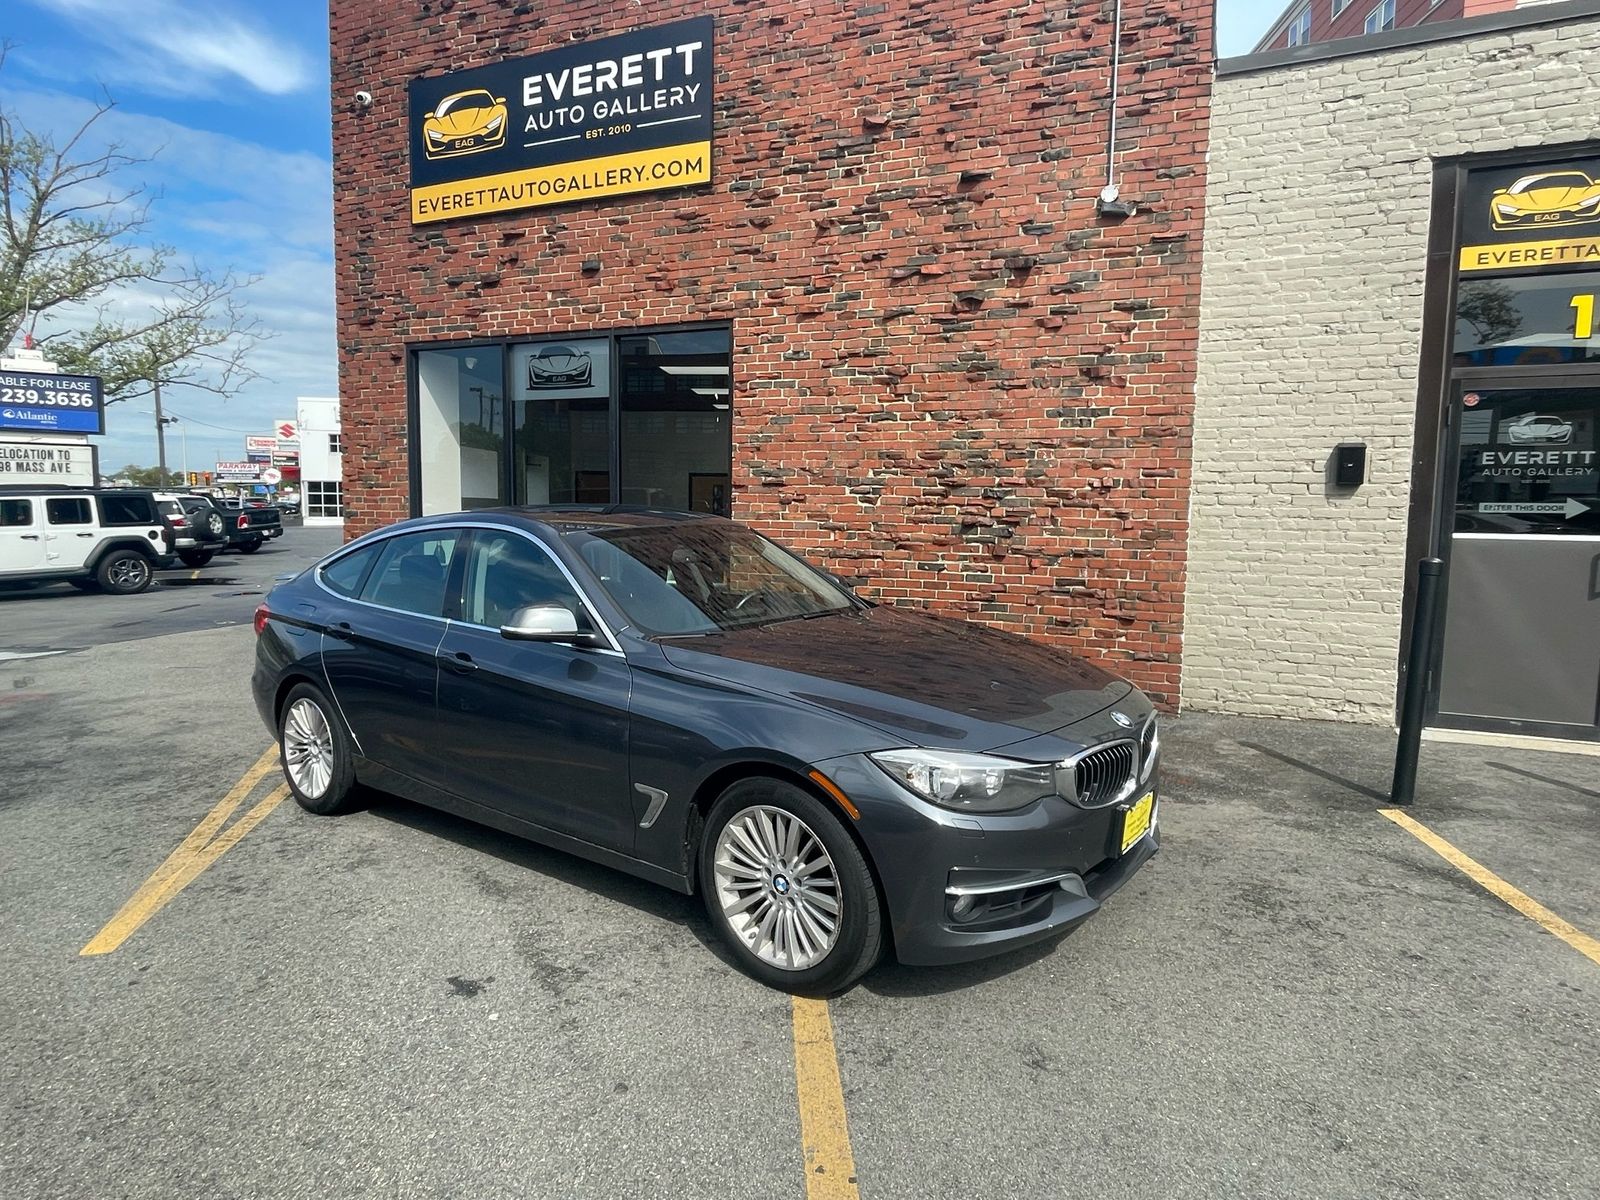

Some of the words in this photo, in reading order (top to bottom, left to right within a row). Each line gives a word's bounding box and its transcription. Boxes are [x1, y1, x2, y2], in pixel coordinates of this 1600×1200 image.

[522, 41, 703, 107] EVERETT
[524, 104, 585, 133] AUTO
[593, 83, 701, 119] GALLERY
[585, 128, 606, 139] EST.
[608, 124, 632, 136] 2010
[454, 138, 475, 149] EAG
[418, 156, 703, 215] EVERETTAUTOGALLERY.COM
[1534, 213, 1560, 222] EAG
[1569, 293, 1596, 339] 1
[30, 379, 53, 388] FOR
[57, 380, 91, 391] LEASE
[16, 410, 57, 421] Atlantic
[59, 450, 71, 460] TO
[1482, 451, 1596, 465] EVERETT
[16, 462, 45, 473] MASS
[51, 462, 71, 473] AVE
[1482, 468, 1521, 476] AUTO
[1527, 467, 1593, 476] GALLERY
